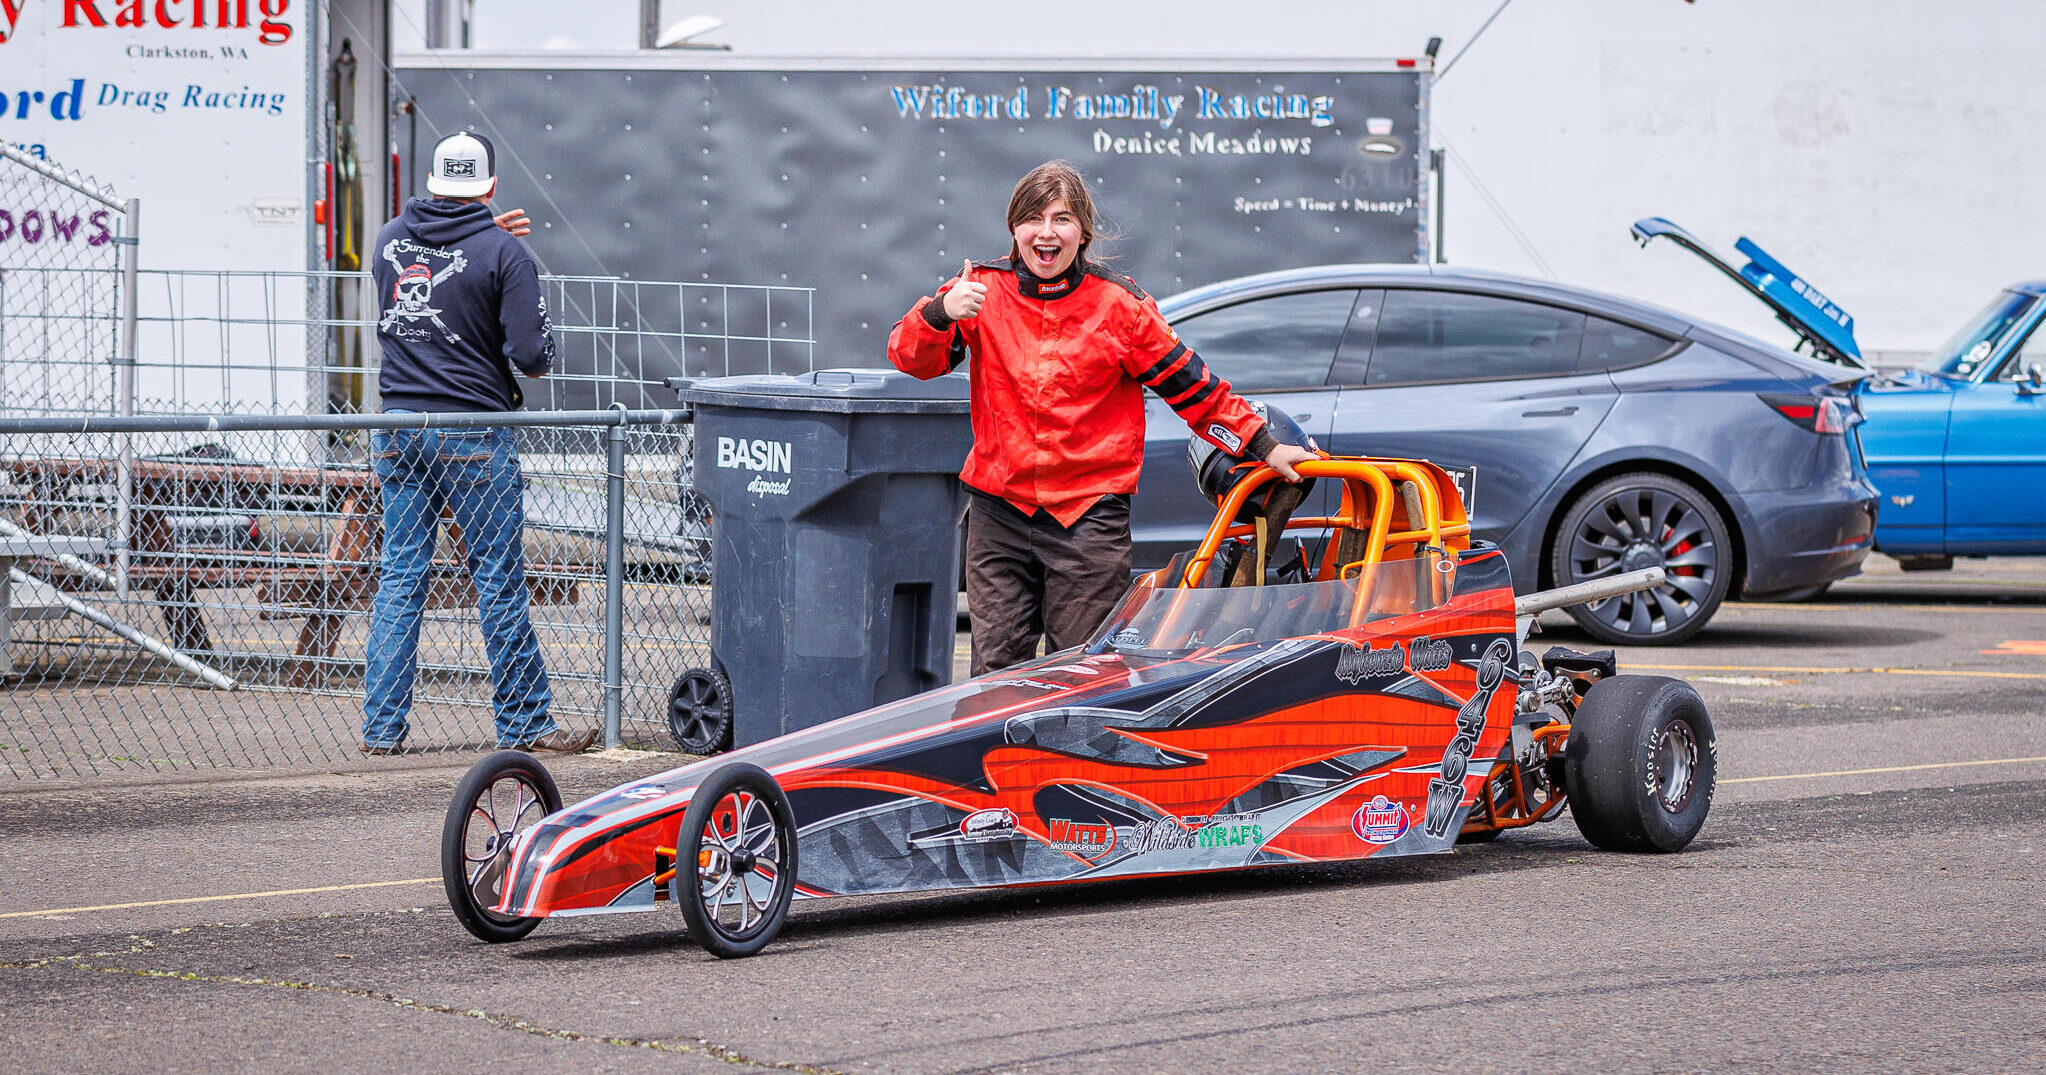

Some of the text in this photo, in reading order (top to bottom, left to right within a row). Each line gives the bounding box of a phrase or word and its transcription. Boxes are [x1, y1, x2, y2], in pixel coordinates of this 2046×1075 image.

[57, 0, 294, 46] Racing
[126, 45, 248, 60] Clarkston, WA
[97, 83, 170, 114] Drag
[182, 84, 286, 116] Racing
[890, 84, 1334, 129] Wiford Family Racing
[1093, 130, 1312, 155] Denice Meadows
[256, 206, 298, 217] TNT
[396, 238, 456, 260] Surrender
[415, 253, 430, 264] the
[717, 436, 792, 474] BASIN
[747, 474, 792, 499] disposal
[1409, 636, 1453, 673] Watts
[1644, 727, 1660, 797] Hoosier
[1050, 818, 1109, 844] WATTS
[1197, 824, 1263, 849] WRAPS
[1050, 842, 1106, 853] MOTORSPORTS
